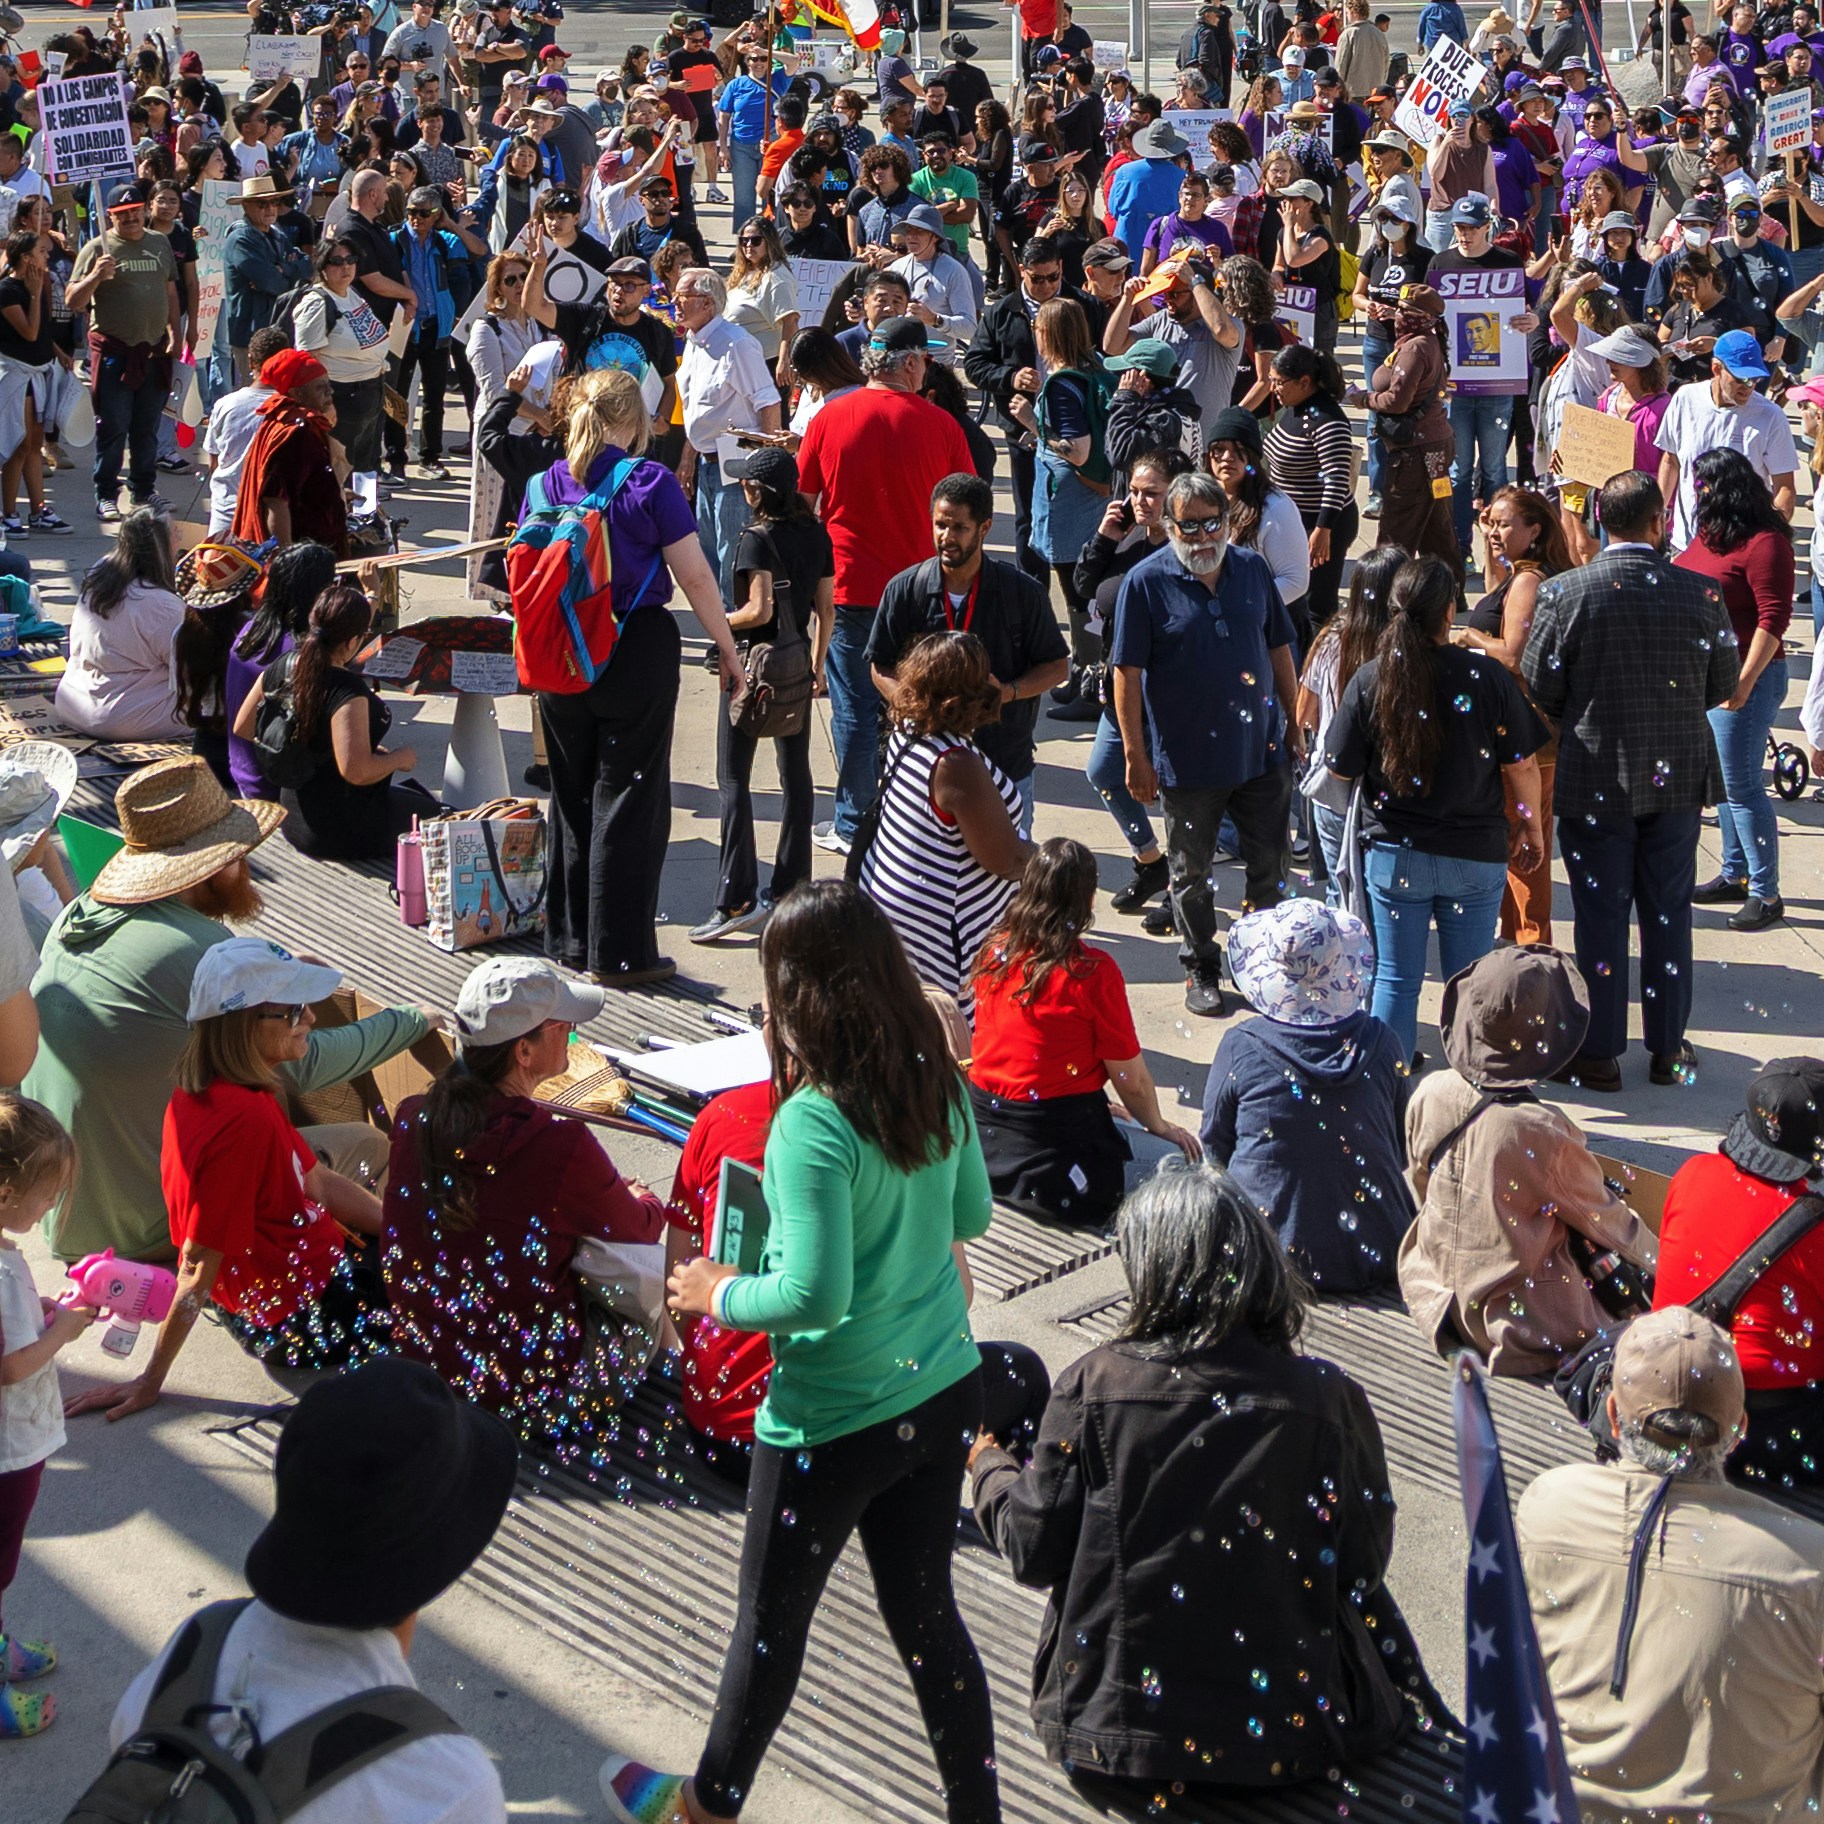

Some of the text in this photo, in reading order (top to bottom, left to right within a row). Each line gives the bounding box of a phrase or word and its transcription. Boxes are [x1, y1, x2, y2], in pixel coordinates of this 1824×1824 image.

[1439, 41, 1475, 74] DUE
[1420, 57, 1470, 102] PROCESS
[43, 76, 119, 106] NO A LOS CAMPOS
[1409, 79, 1448, 129] NOW
[1768, 93, 1809, 112] IMMIGRANTS
[46, 110, 58, 131] DE
[1770, 118, 1810, 138] AMERICA
[54, 128, 126, 155] SOLIDARIDAD
[1773, 131, 1806, 151] GREAT
[57, 155, 74, 171] CON
[121, 260, 157, 272] PUMA
[1438, 272, 1517, 296] SEIU
[1275, 287, 1311, 307] EIU
[456, 835, 475, 846] ALL
[456, 855, 470, 865] UP
